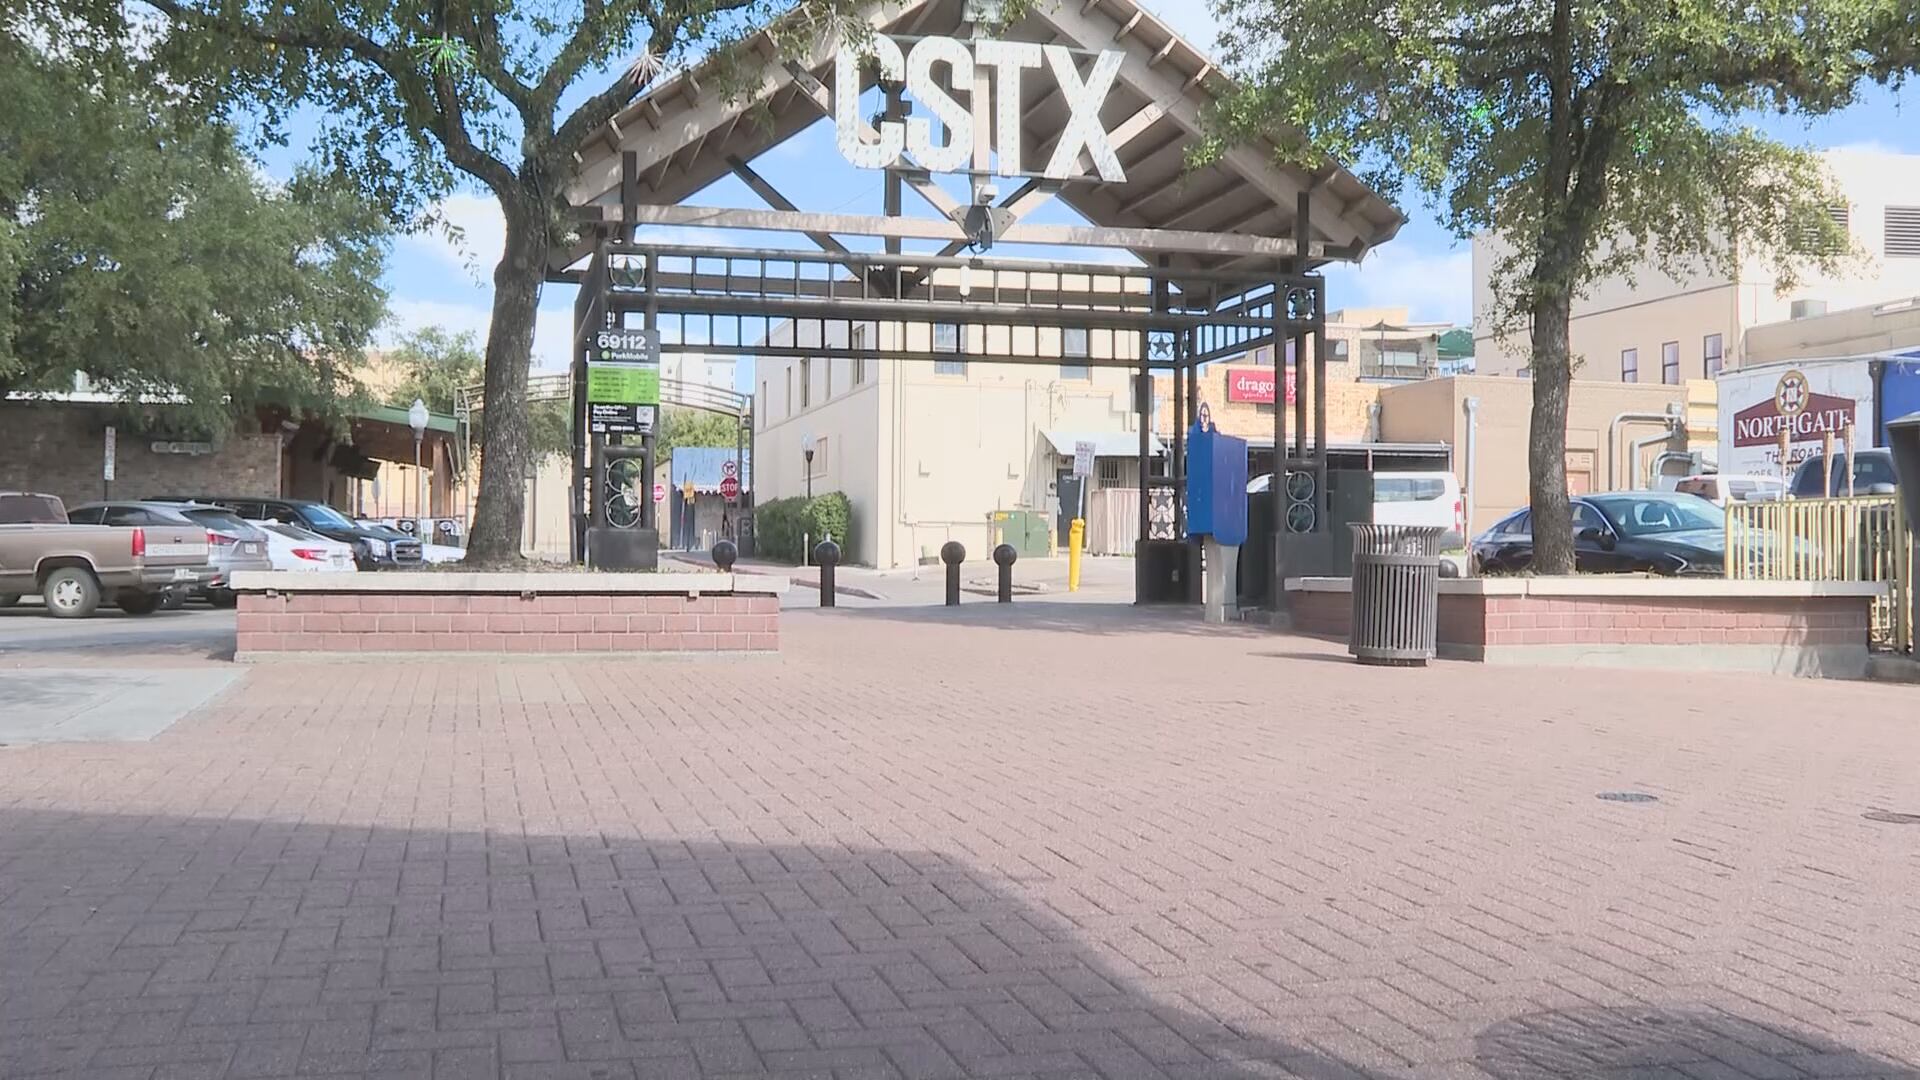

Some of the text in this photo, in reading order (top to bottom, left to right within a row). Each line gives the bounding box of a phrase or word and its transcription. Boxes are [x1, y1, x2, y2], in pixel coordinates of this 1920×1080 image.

[835, 33, 1127, 183] CSTX
[597, 334, 646, 350] 69112
[1237, 374, 1296, 395] dragoly
[1737, 408, 1851, 440] NORTHGATE
[1765, 450, 1785, 462] TH
